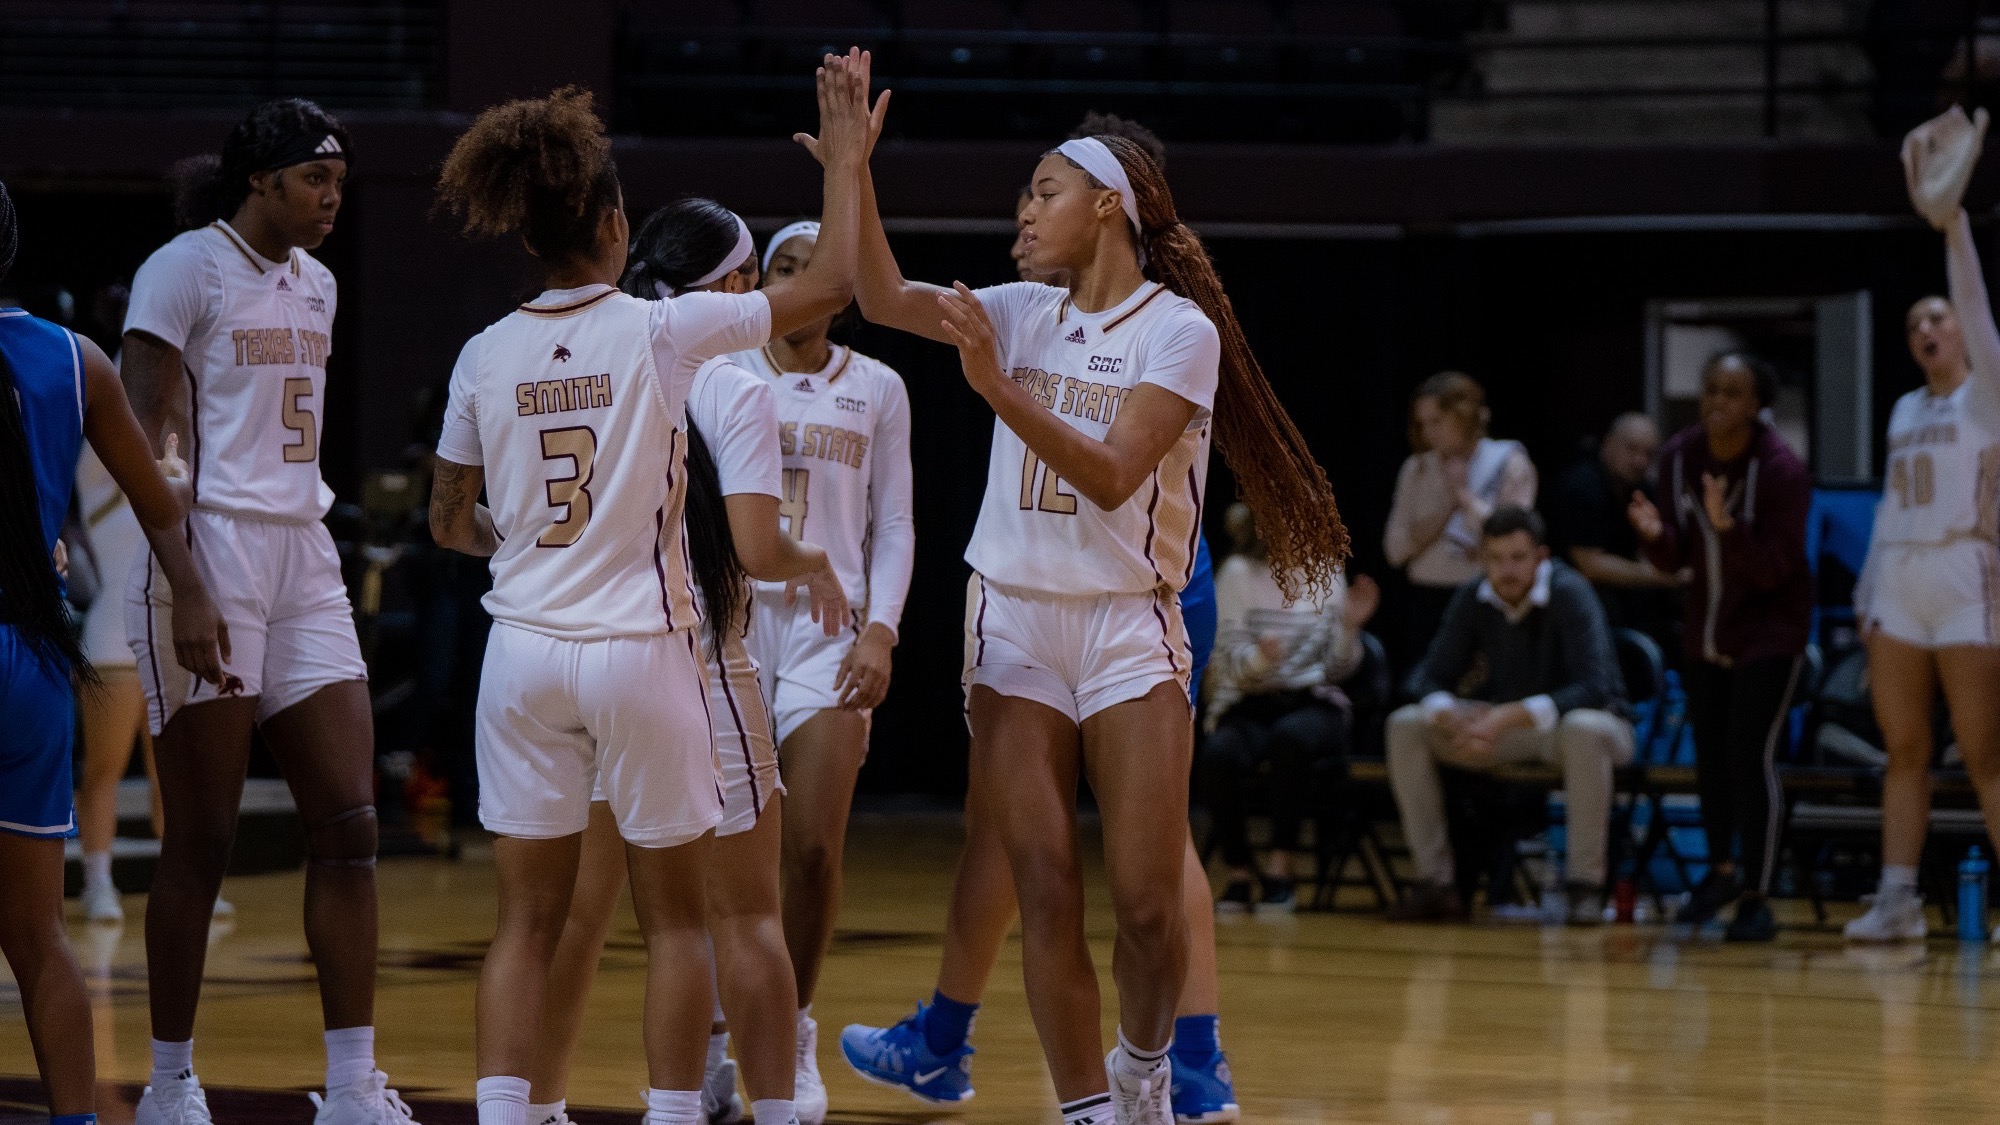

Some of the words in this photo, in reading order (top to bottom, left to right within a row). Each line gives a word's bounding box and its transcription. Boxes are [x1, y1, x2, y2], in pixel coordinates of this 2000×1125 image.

[232, 328, 296, 366] TEXAS
[298, 328, 328, 368] STAT
[1088, 355, 1122, 373] SBC
[516, 373, 613, 417] SMITH
[836, 396, 866, 414] SBC
[282, 377, 317, 463] 5
[802, 423, 870, 469] STATE
[536, 425, 597, 548] 3
